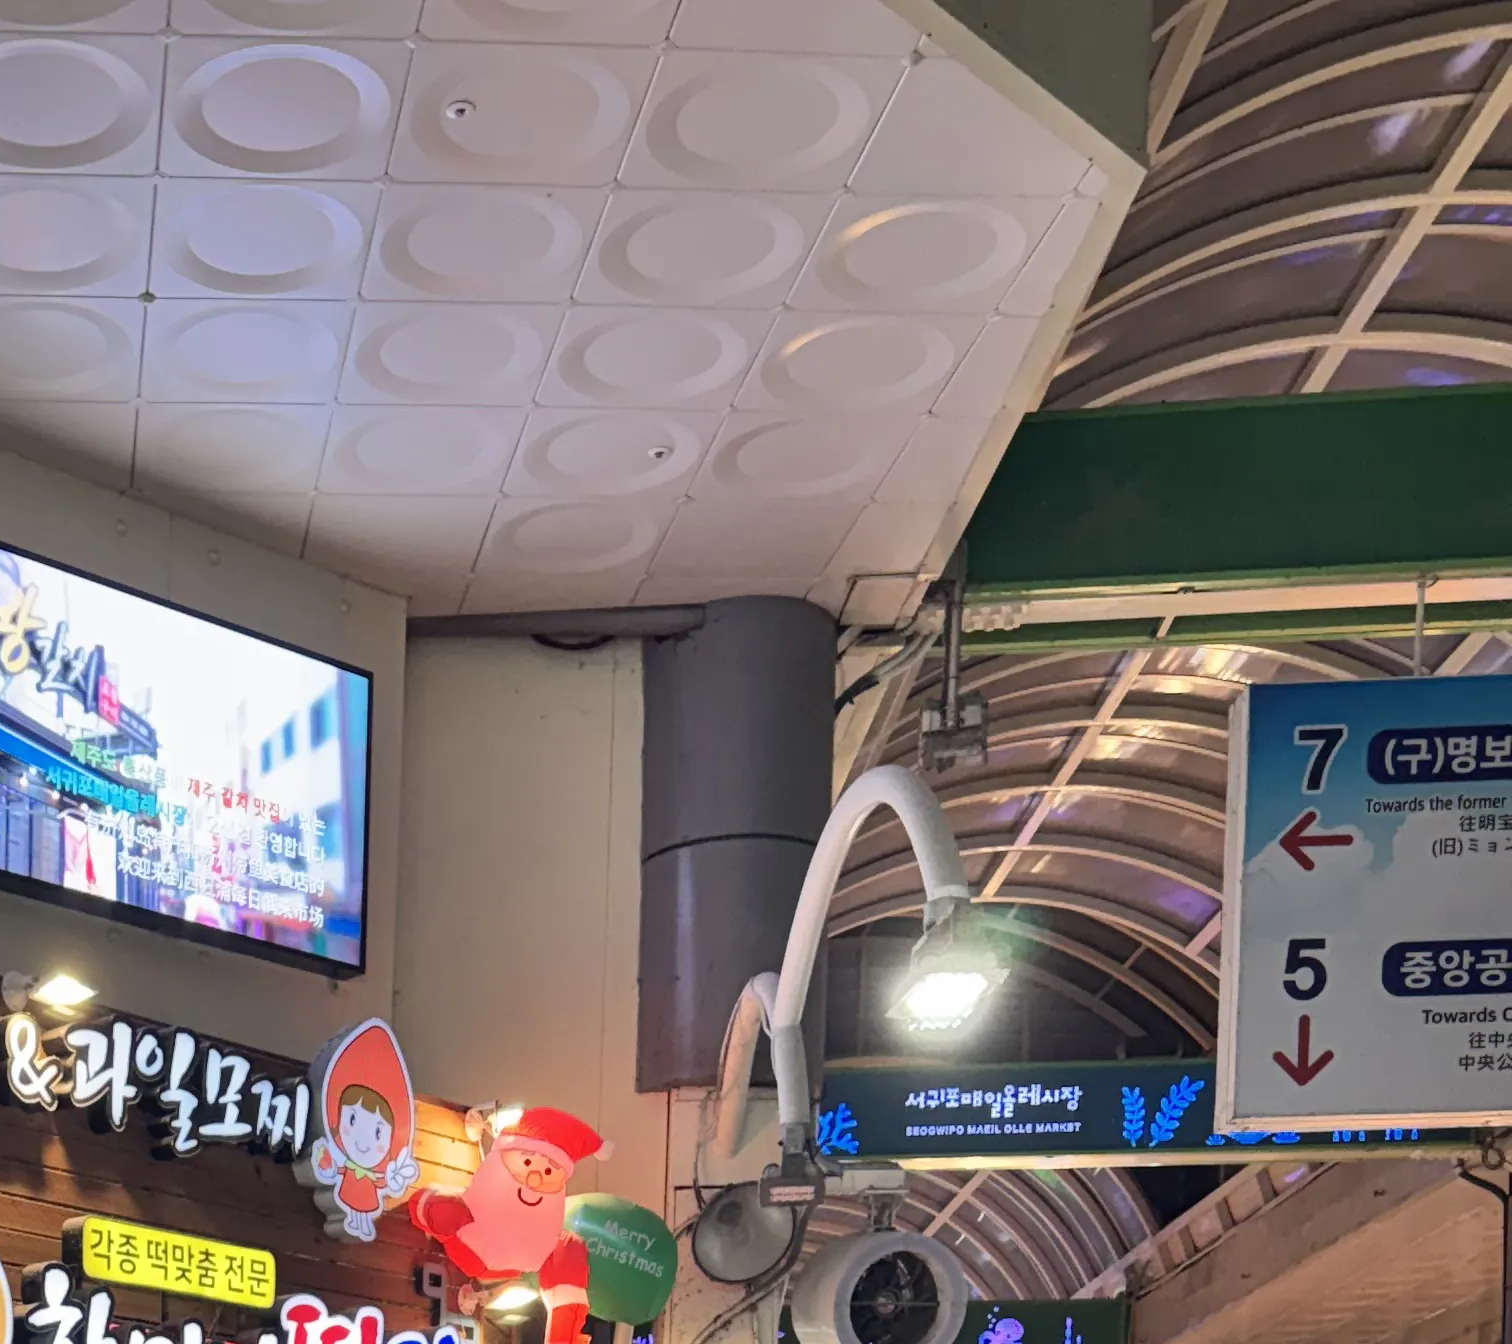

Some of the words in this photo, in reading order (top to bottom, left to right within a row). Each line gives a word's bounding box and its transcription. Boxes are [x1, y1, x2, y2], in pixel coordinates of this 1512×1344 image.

[1295, 726, 1346, 793] 7
[1365, 798, 1425, 814] Towards
[1429, 797, 1453, 812] the
[1457, 794, 1507, 811] former
[1281, 937, 1328, 1001] 5
[1422, 1008, 1498, 1027] Towards
[4, 1014, 59, 1111] &
[66, 1024, 311, 1157] 과일모찌
[904, 1084, 1082, 1118] 서귀포매일올레시장
[905, 1125, 965, 1137] SEOGWIPO
[967, 1124, 1001, 1136] MAEIL
[1004, 1123, 1032, 1135] OLLE
[1035, 1122, 1081, 1134] MARKET
[604, 1219, 656, 1250] Merry
[88, 1226, 143, 1276] 각종
[146, 1237, 222, 1291] 떡맞춤
[224, 1250, 273, 1298] 전문
[588, 1238, 665, 1278] Christmas
